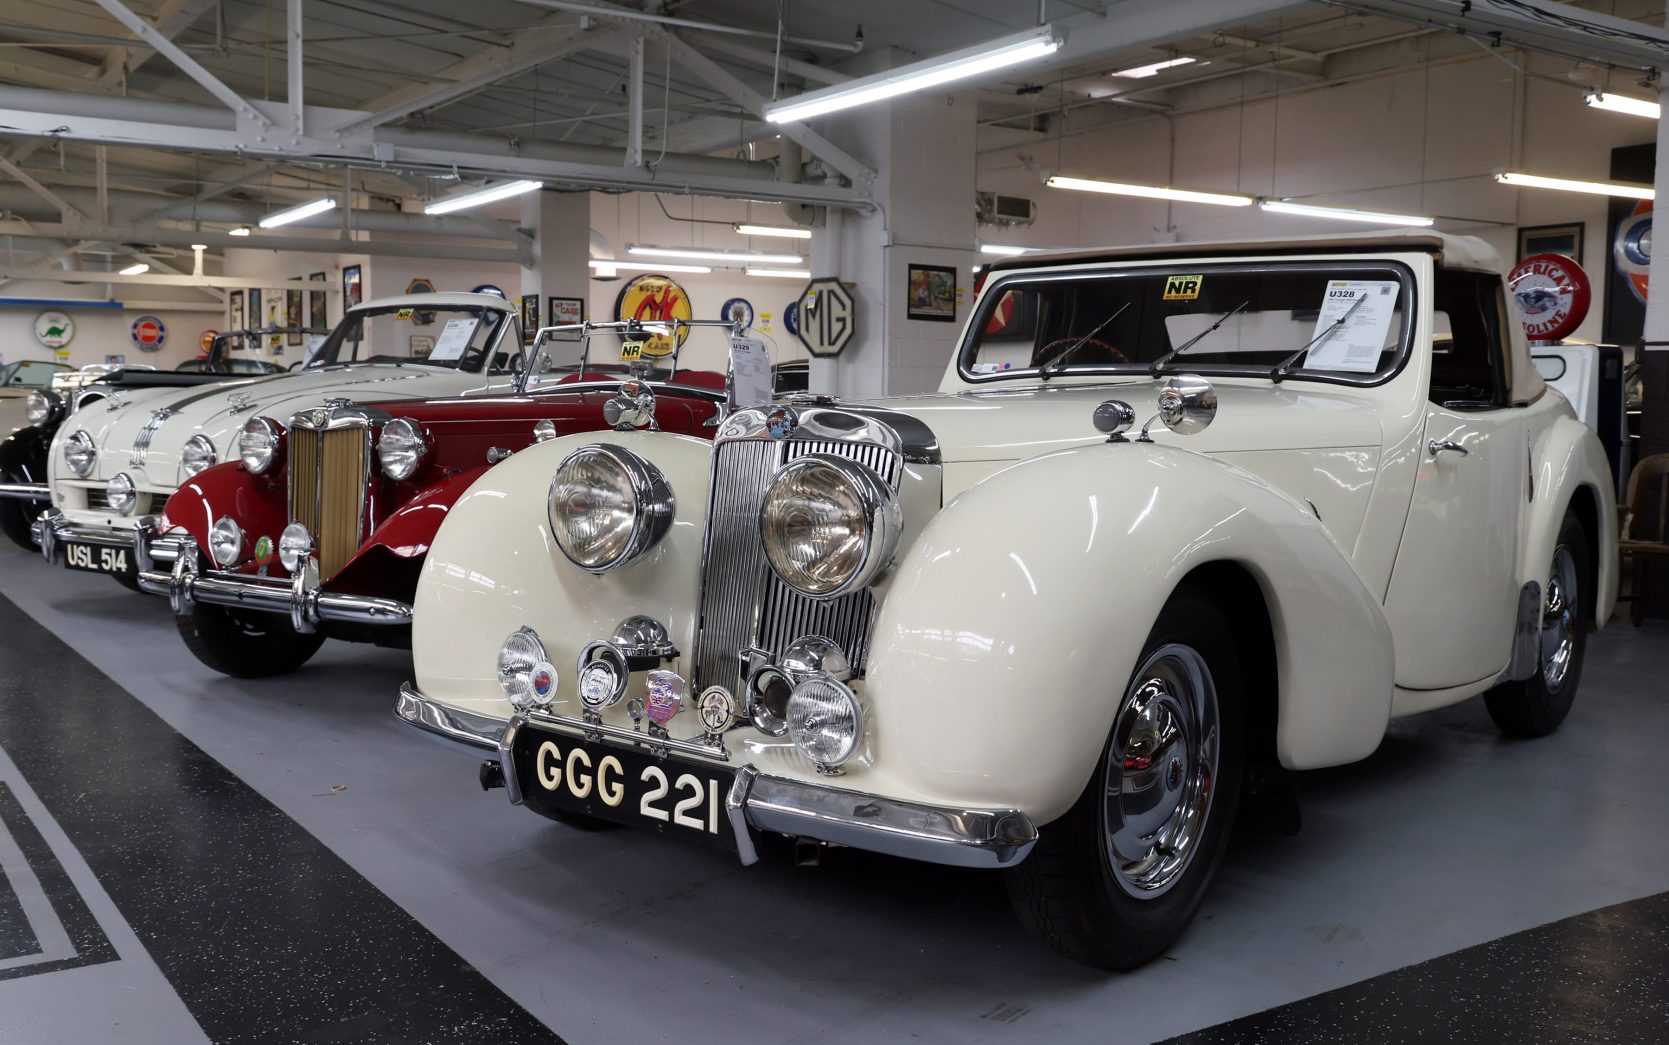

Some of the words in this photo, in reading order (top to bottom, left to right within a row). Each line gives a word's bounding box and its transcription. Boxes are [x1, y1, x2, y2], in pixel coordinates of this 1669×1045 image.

[1167, 281, 1198, 294] NR
[1329, 290, 1355, 298] U328
[805, 290, 846, 346] MG
[622, 345, 640, 356] NR
[732, 343, 750, 351] U329
[67, 544, 98, 569] USL
[101, 547, 127, 572] 514
[536, 740, 625, 807] GGG
[640, 765, 718, 834] 221
